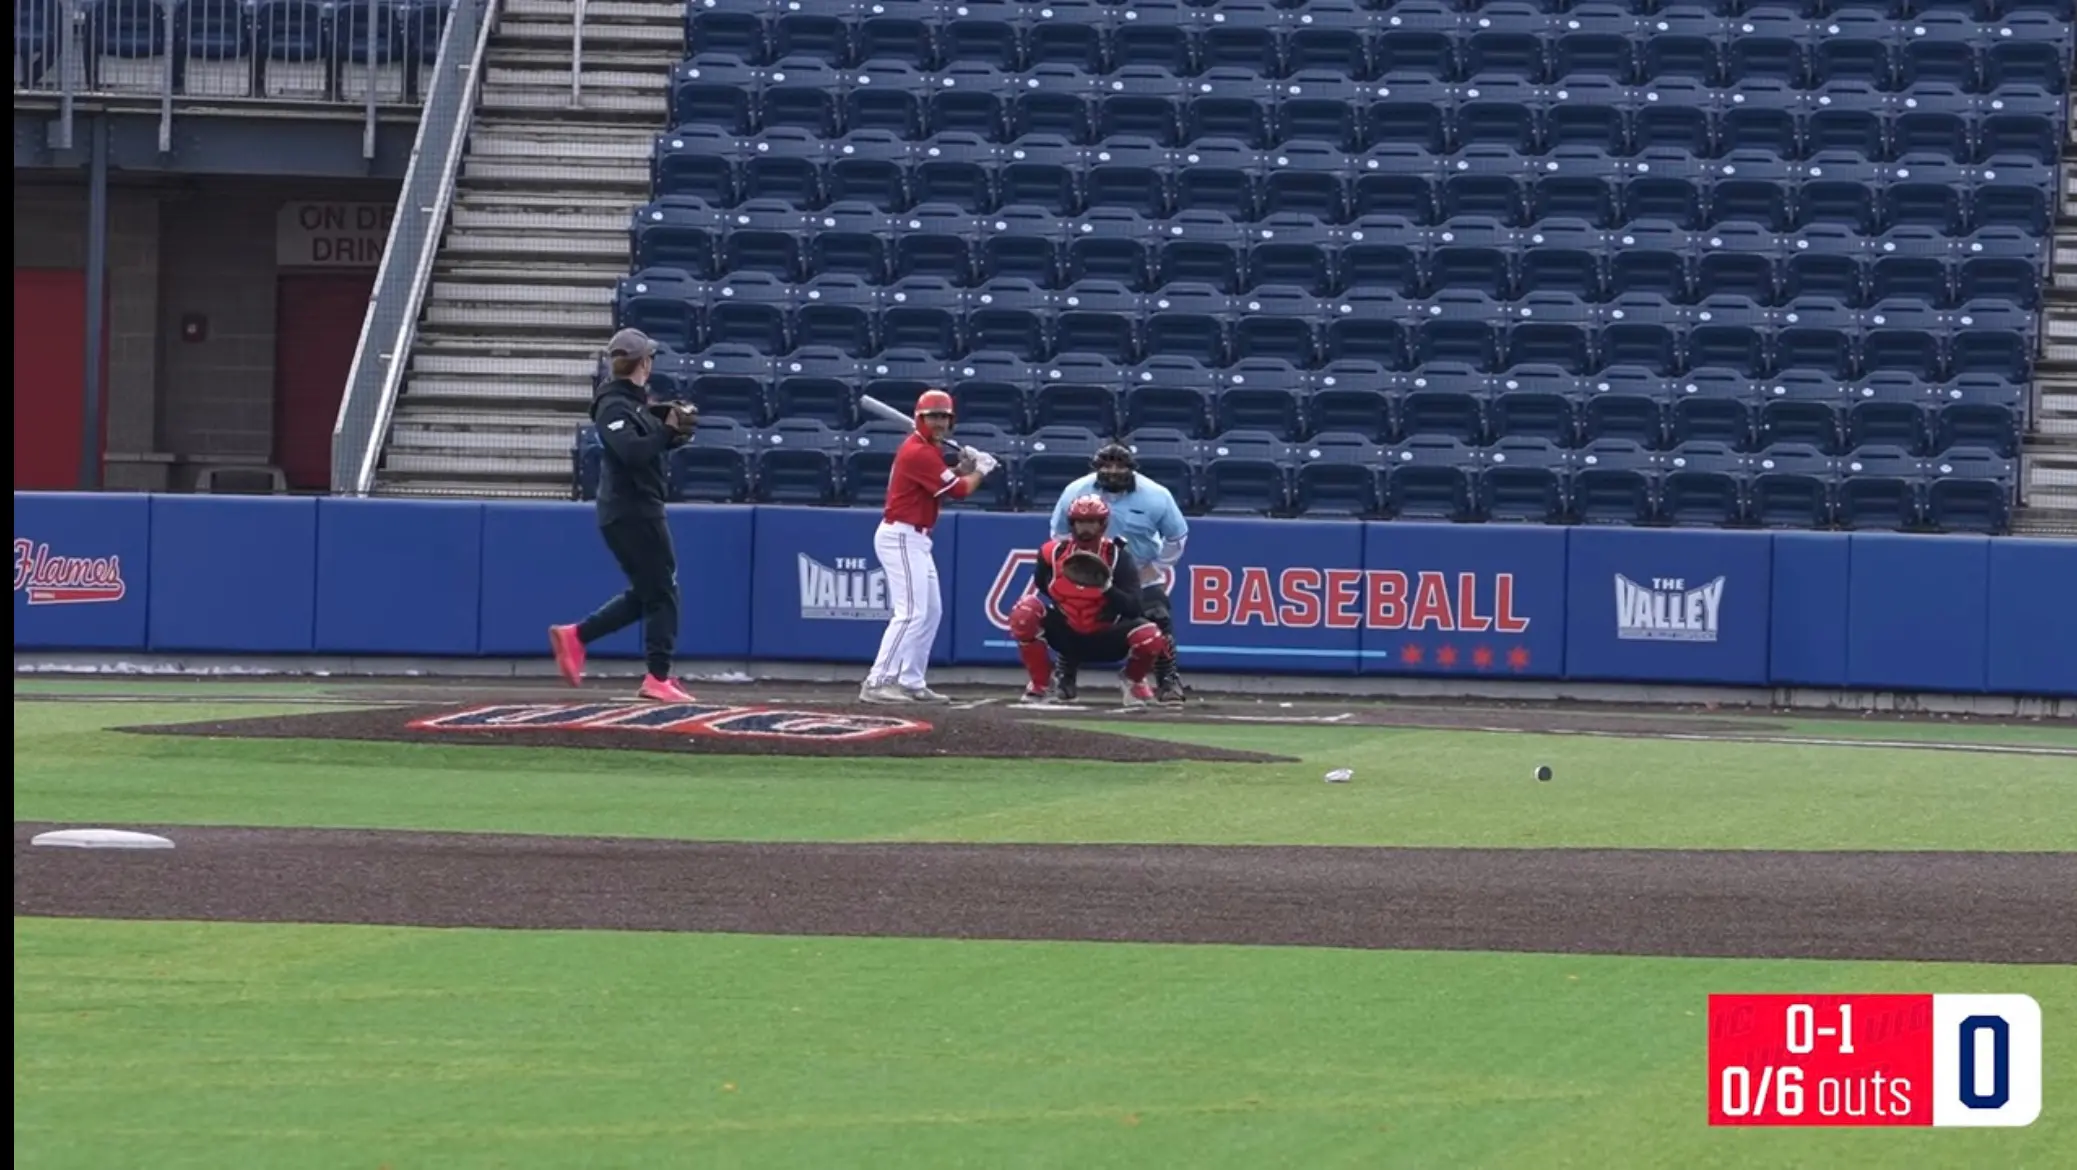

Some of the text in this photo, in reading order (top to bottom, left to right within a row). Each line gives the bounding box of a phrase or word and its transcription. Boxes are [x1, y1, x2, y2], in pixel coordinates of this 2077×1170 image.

[299, 204, 396, 231] ON DE
[313, 237, 386, 262] DRIN
[835, 557, 867, 570] THE
[798, 552, 886, 609] VALLE
[1652, 577, 1685, 590] THE
[1190, 565, 1531, 632] BASEBALL
[1615, 572, 1726, 631] VALLEY
[407, 702, 932, 740] UIC
